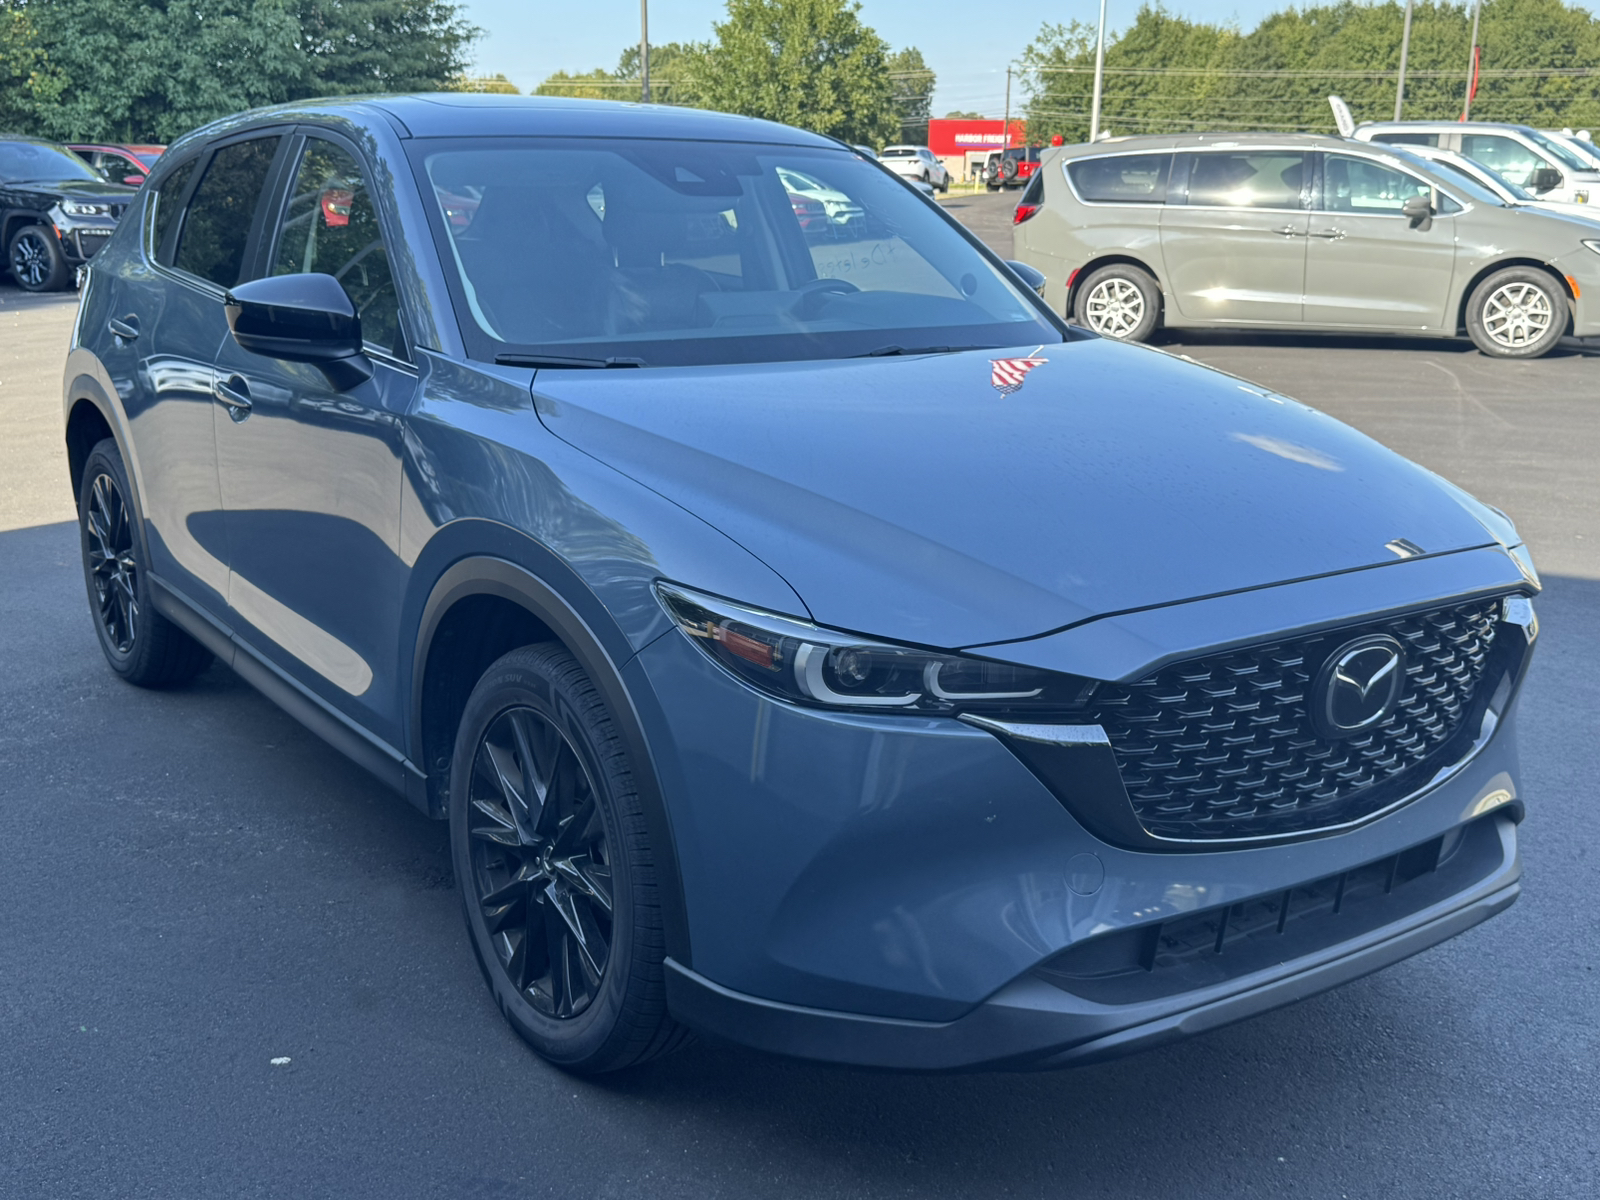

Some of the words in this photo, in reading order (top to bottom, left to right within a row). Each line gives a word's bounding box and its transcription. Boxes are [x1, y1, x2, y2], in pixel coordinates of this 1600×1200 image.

[955, 133, 983, 143] HARBOR
[983, 133, 1012, 144] FREIGHT
[504, 673, 523, 683] SUV
